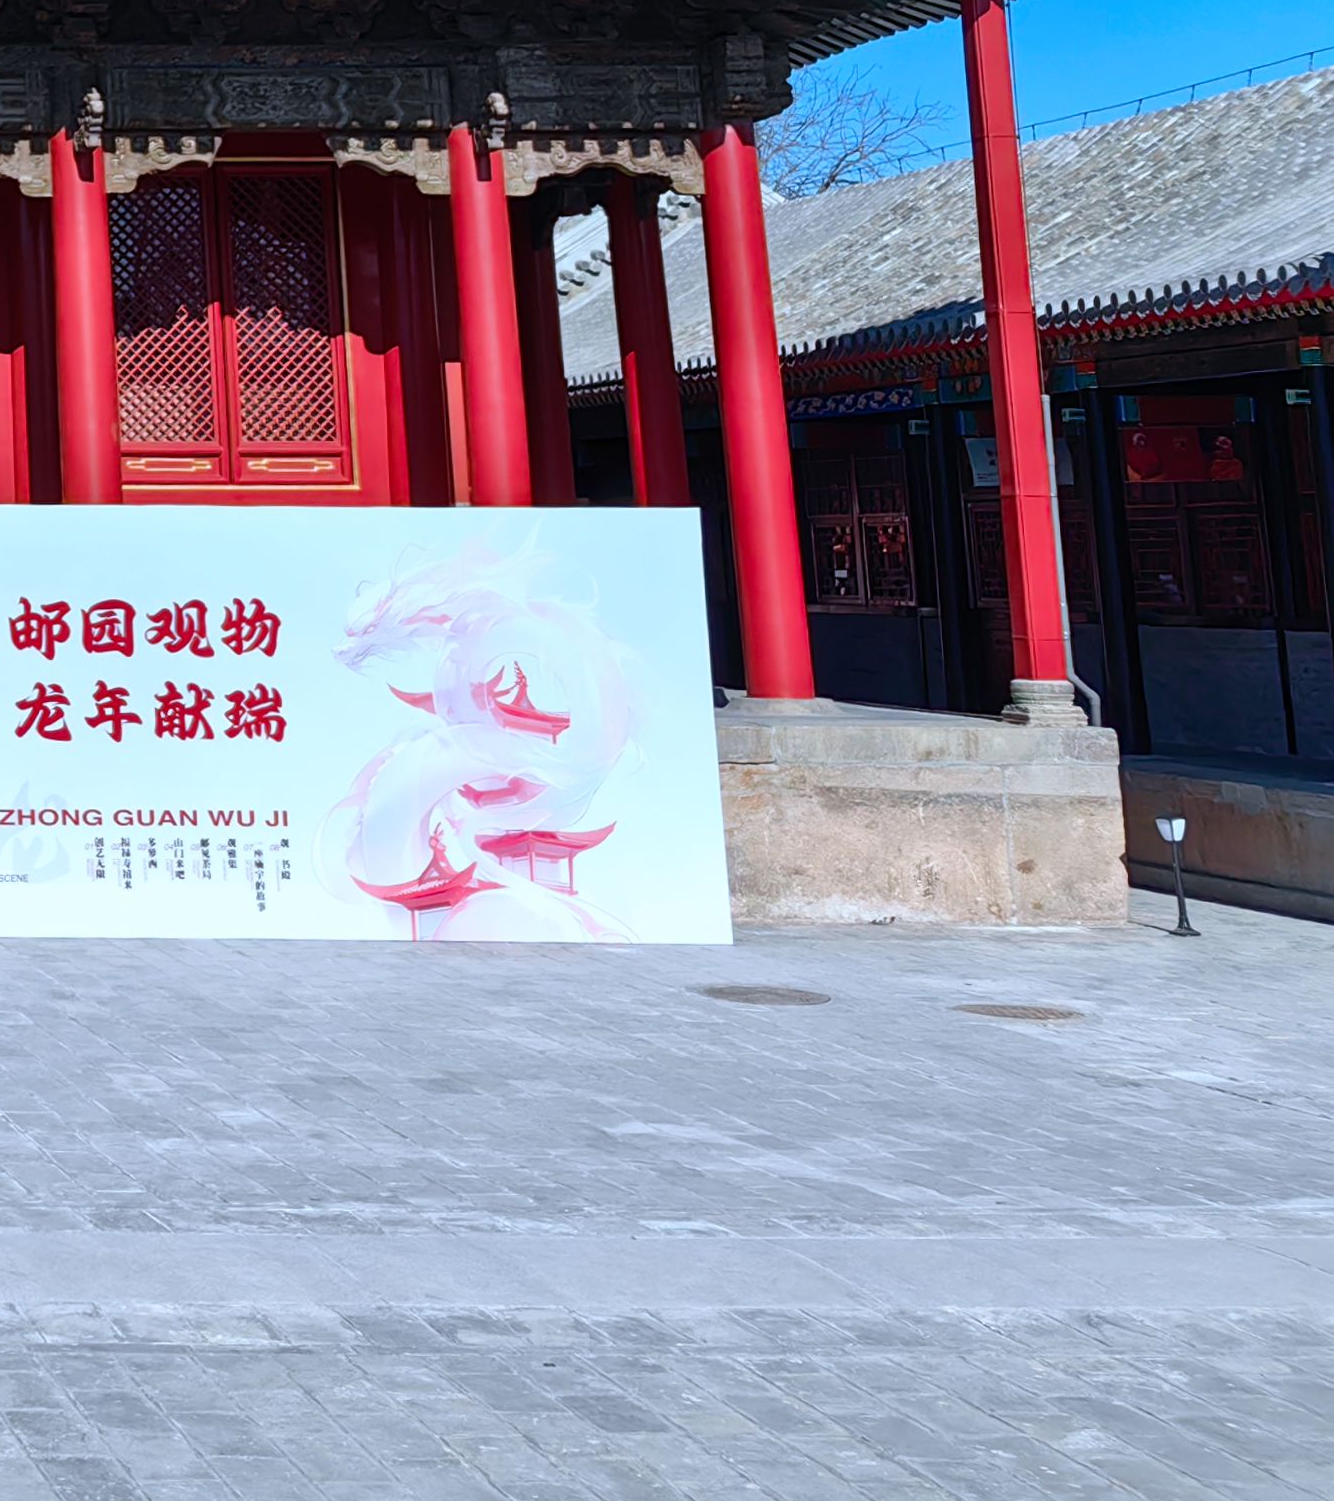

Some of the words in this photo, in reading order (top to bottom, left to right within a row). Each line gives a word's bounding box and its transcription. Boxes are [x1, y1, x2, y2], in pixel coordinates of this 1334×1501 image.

[8, 596, 282, 661] 邮园观物
[14, 680, 287, 742] 龙年献瑞
[112, 809, 198, 827] GUAN
[207, 809, 256, 827] WU
[265, 809, 289, 827] JI
